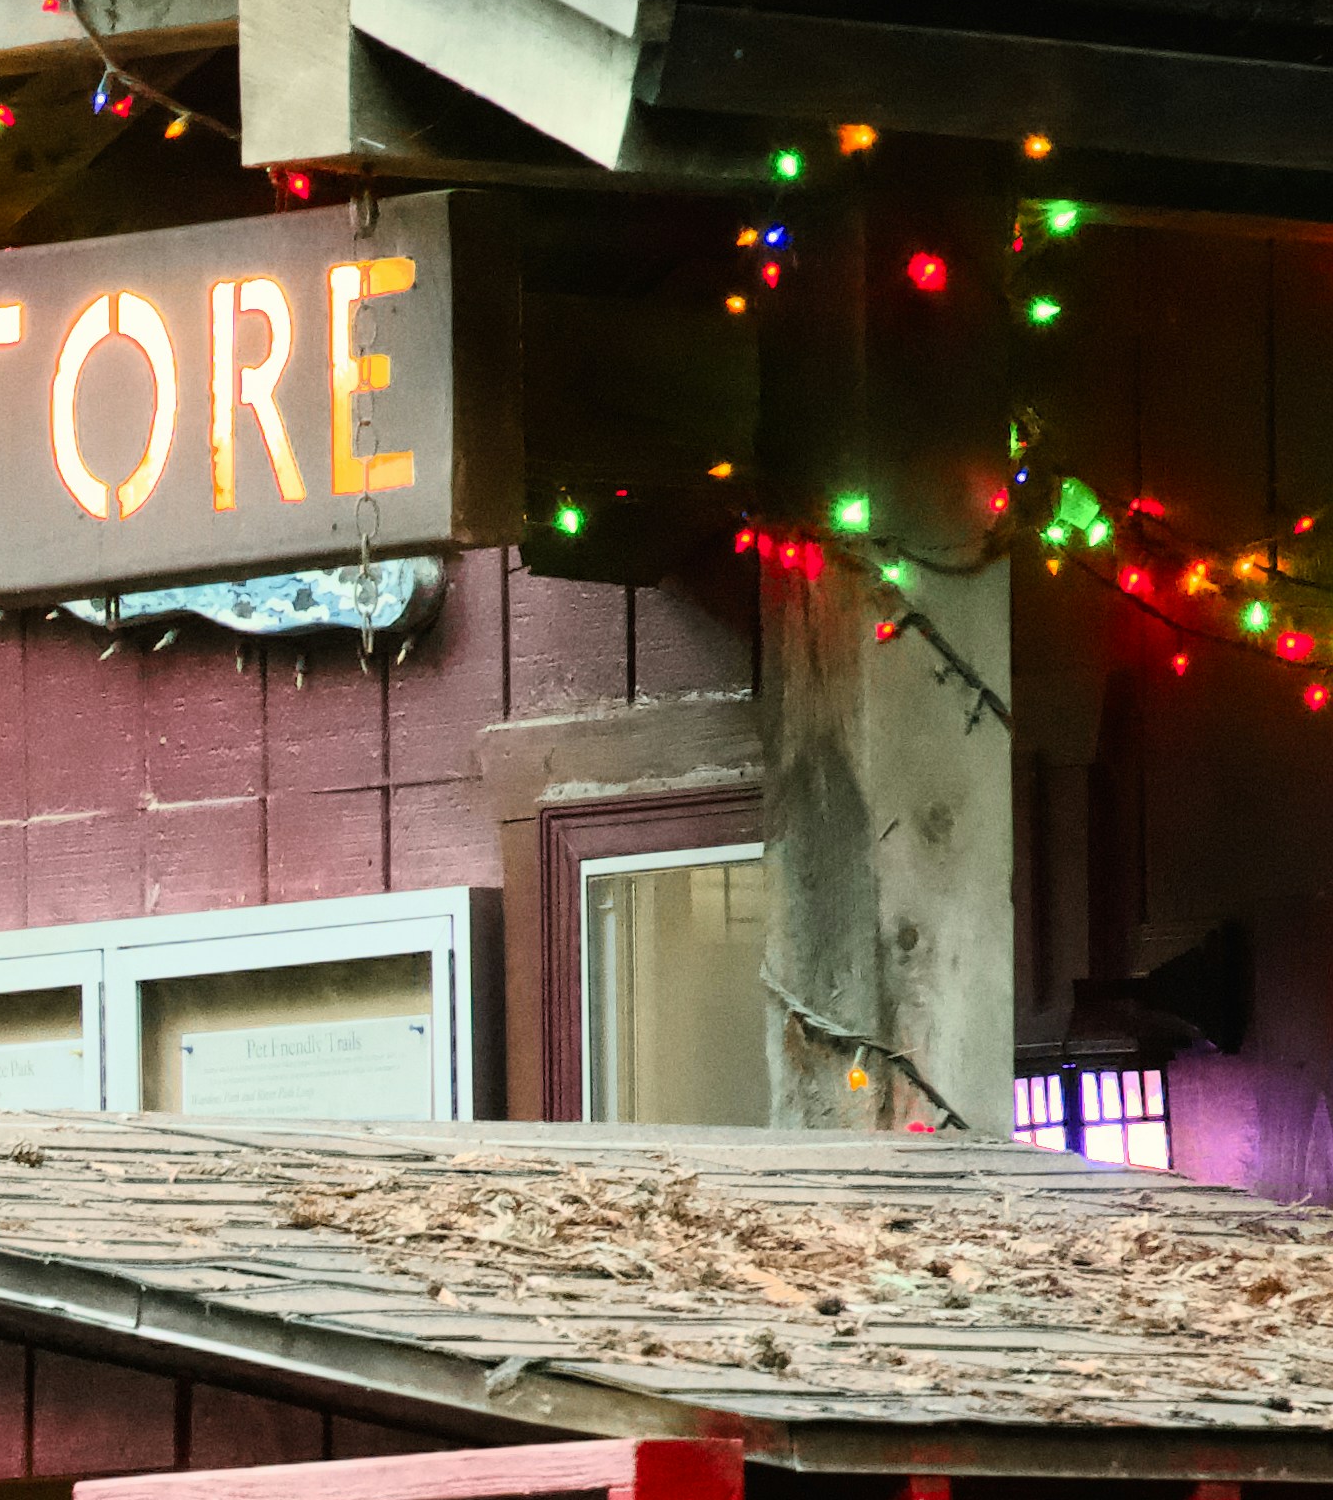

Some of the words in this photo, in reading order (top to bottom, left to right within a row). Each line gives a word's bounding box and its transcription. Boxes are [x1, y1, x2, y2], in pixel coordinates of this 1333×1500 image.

[247, 1039, 267, 1059] Pet
[271, 1035, 322, 1058] Friendly
[325, 1031, 362, 1053] Trails
[10, 1059, 35, 1077] Park
